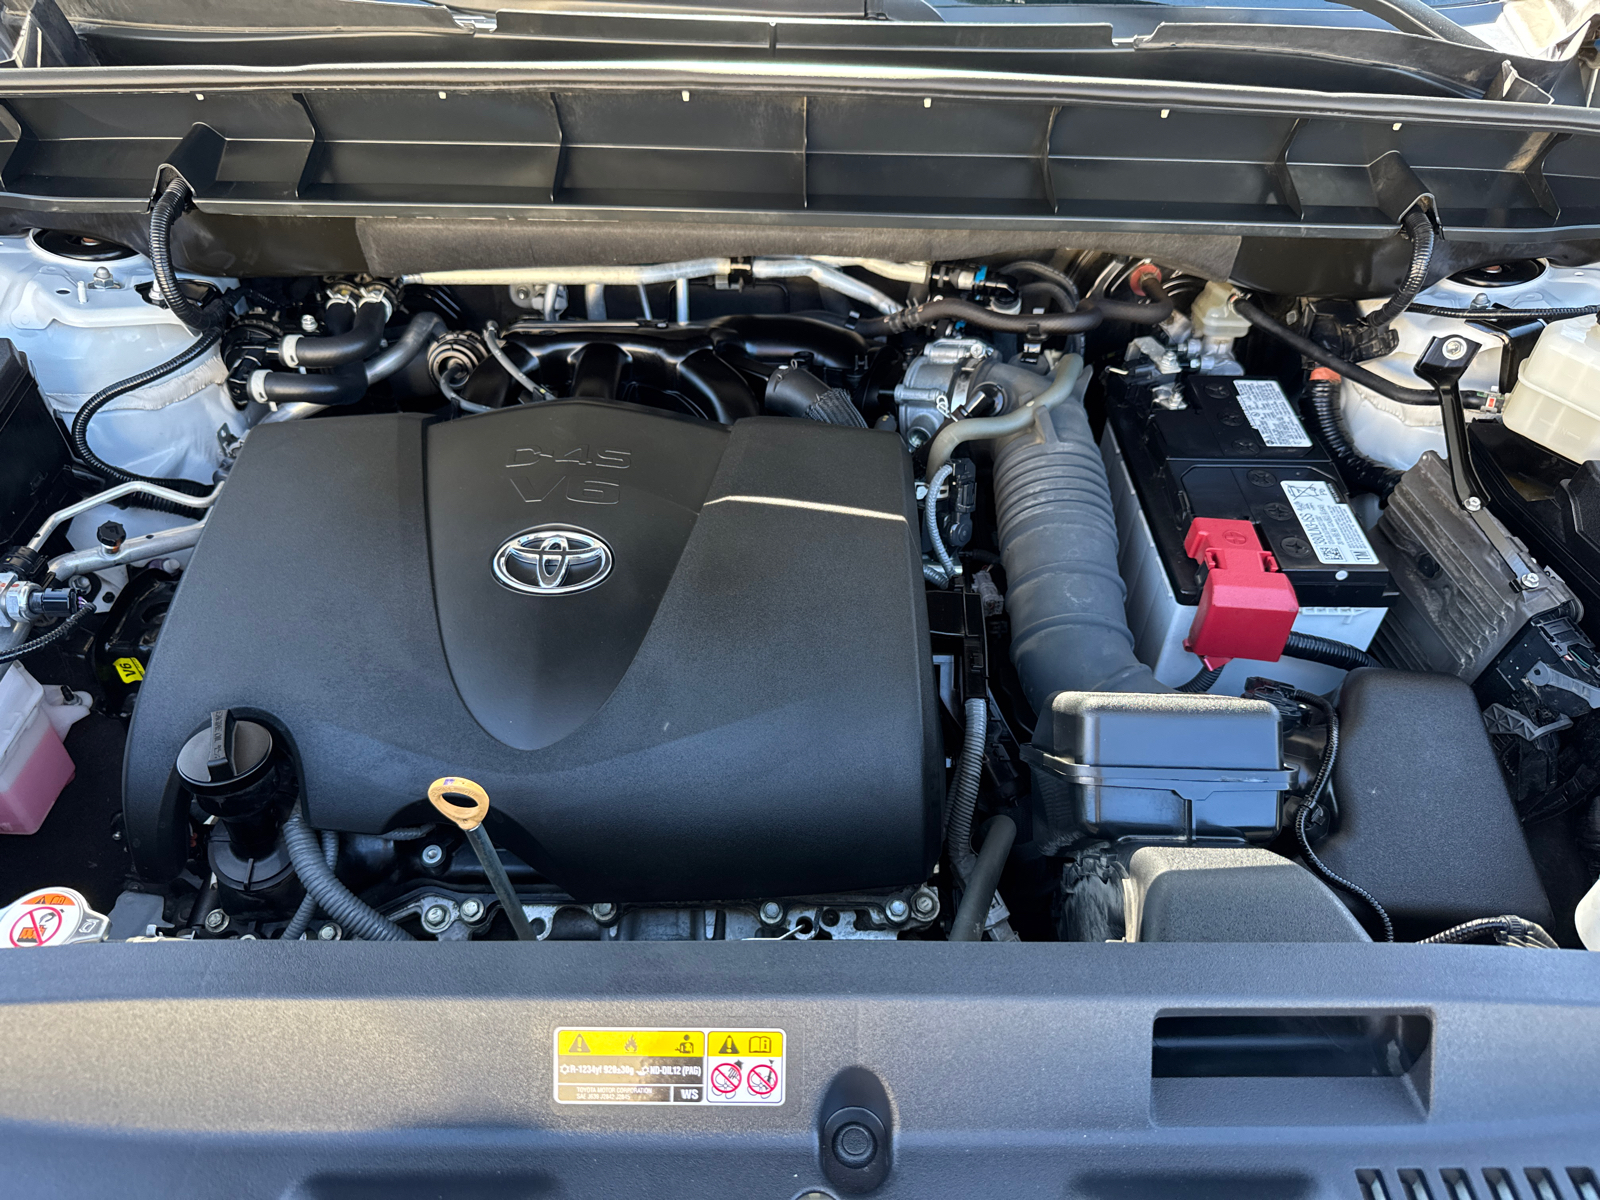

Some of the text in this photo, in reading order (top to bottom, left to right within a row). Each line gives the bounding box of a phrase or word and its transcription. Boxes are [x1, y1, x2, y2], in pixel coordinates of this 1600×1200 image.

[504, 444, 632, 469] D-4S
[506, 475, 620, 505] V6
[119, 662, 136, 678] V6
[682, 1065, 702, 1077] (PAG)
[576, 1086, 653, 1095] TOYOTA MOTOR CORPORATION
[680, 1088, 700, 1100] WS
